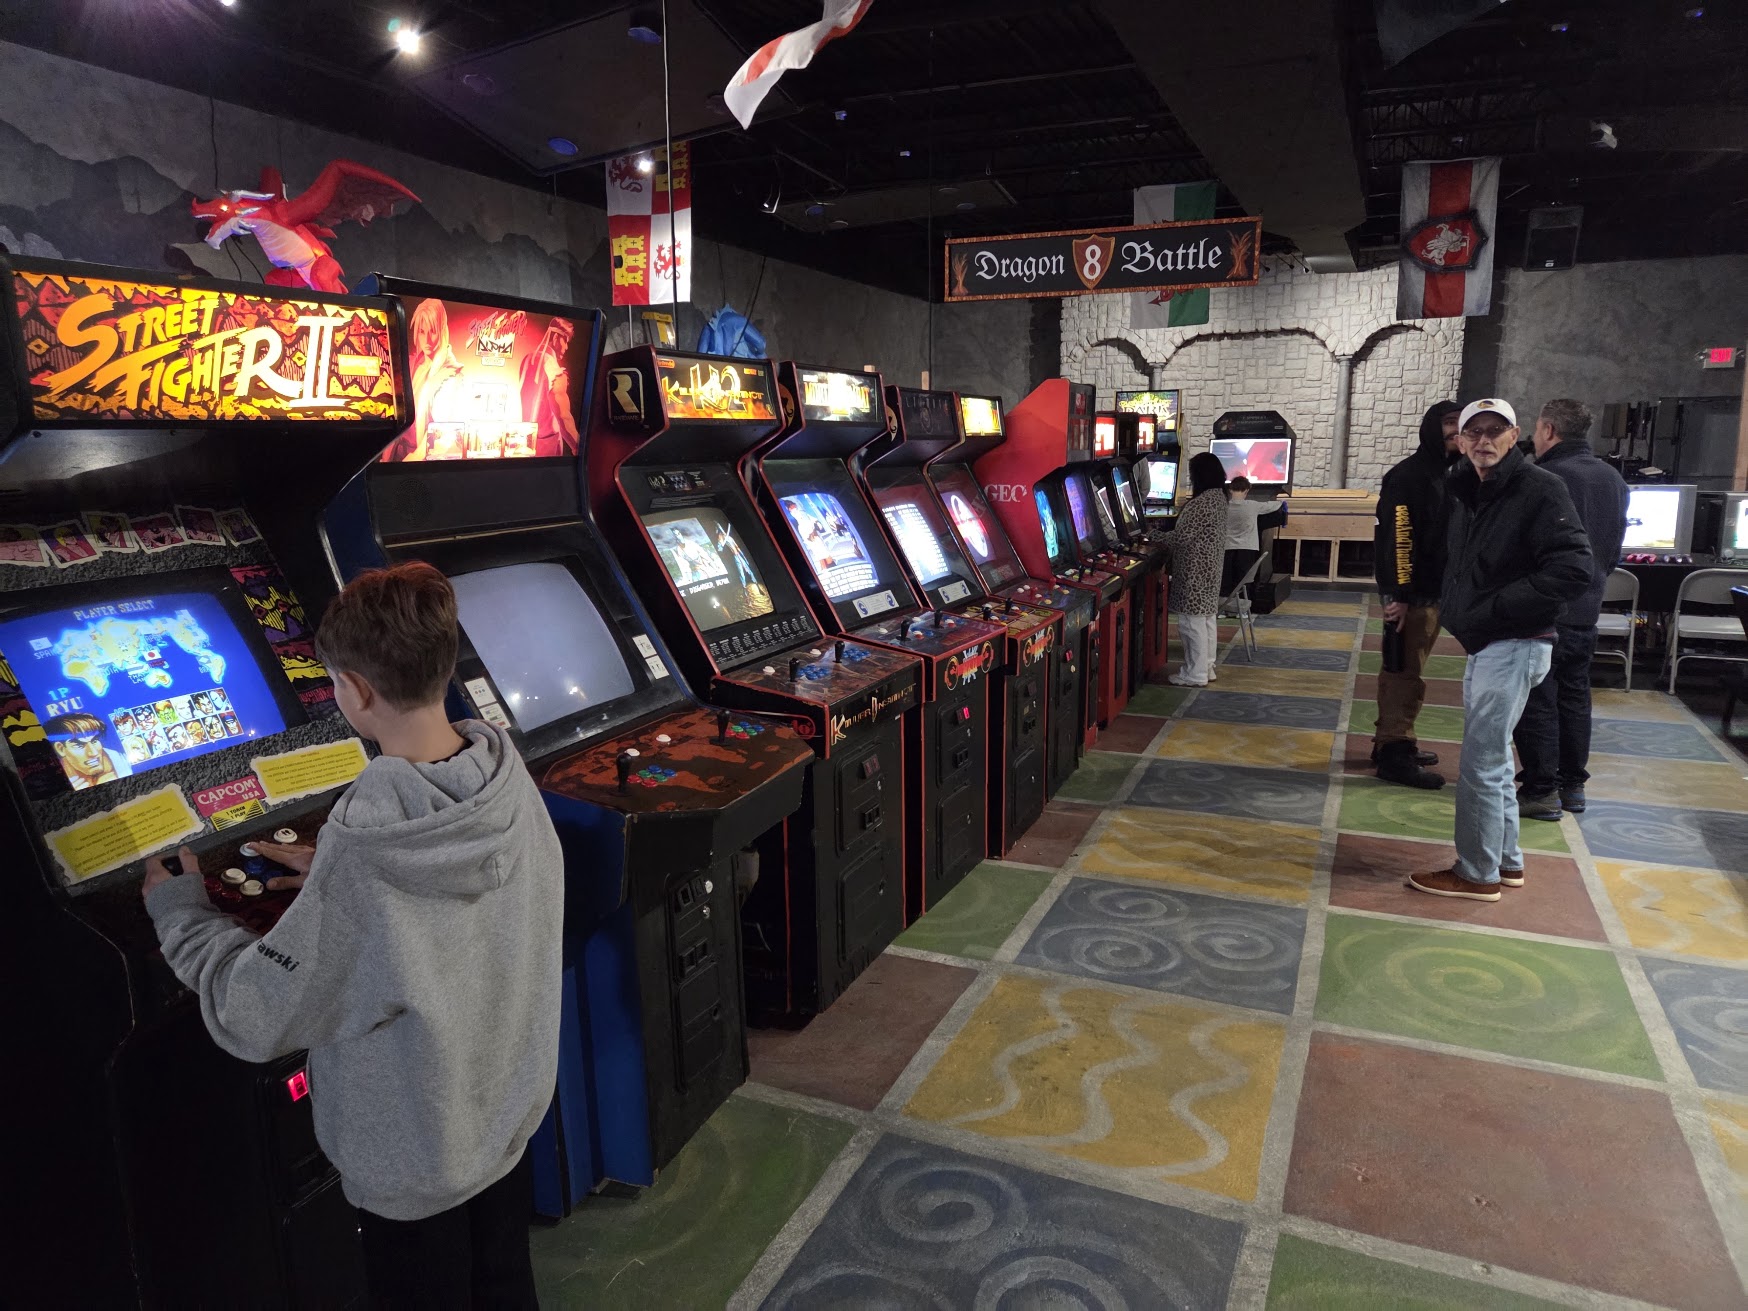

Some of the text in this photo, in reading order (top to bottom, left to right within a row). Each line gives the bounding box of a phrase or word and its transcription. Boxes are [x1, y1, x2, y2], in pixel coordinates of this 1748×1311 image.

[974, 238, 1223, 283] Dragon 8 Battle
[73, 599, 156, 621] PLAYER SELECT
[46, 696, 84, 717] RYU
[197, 779, 257, 805] CAPCOM
[241, 790, 261, 800] USA
